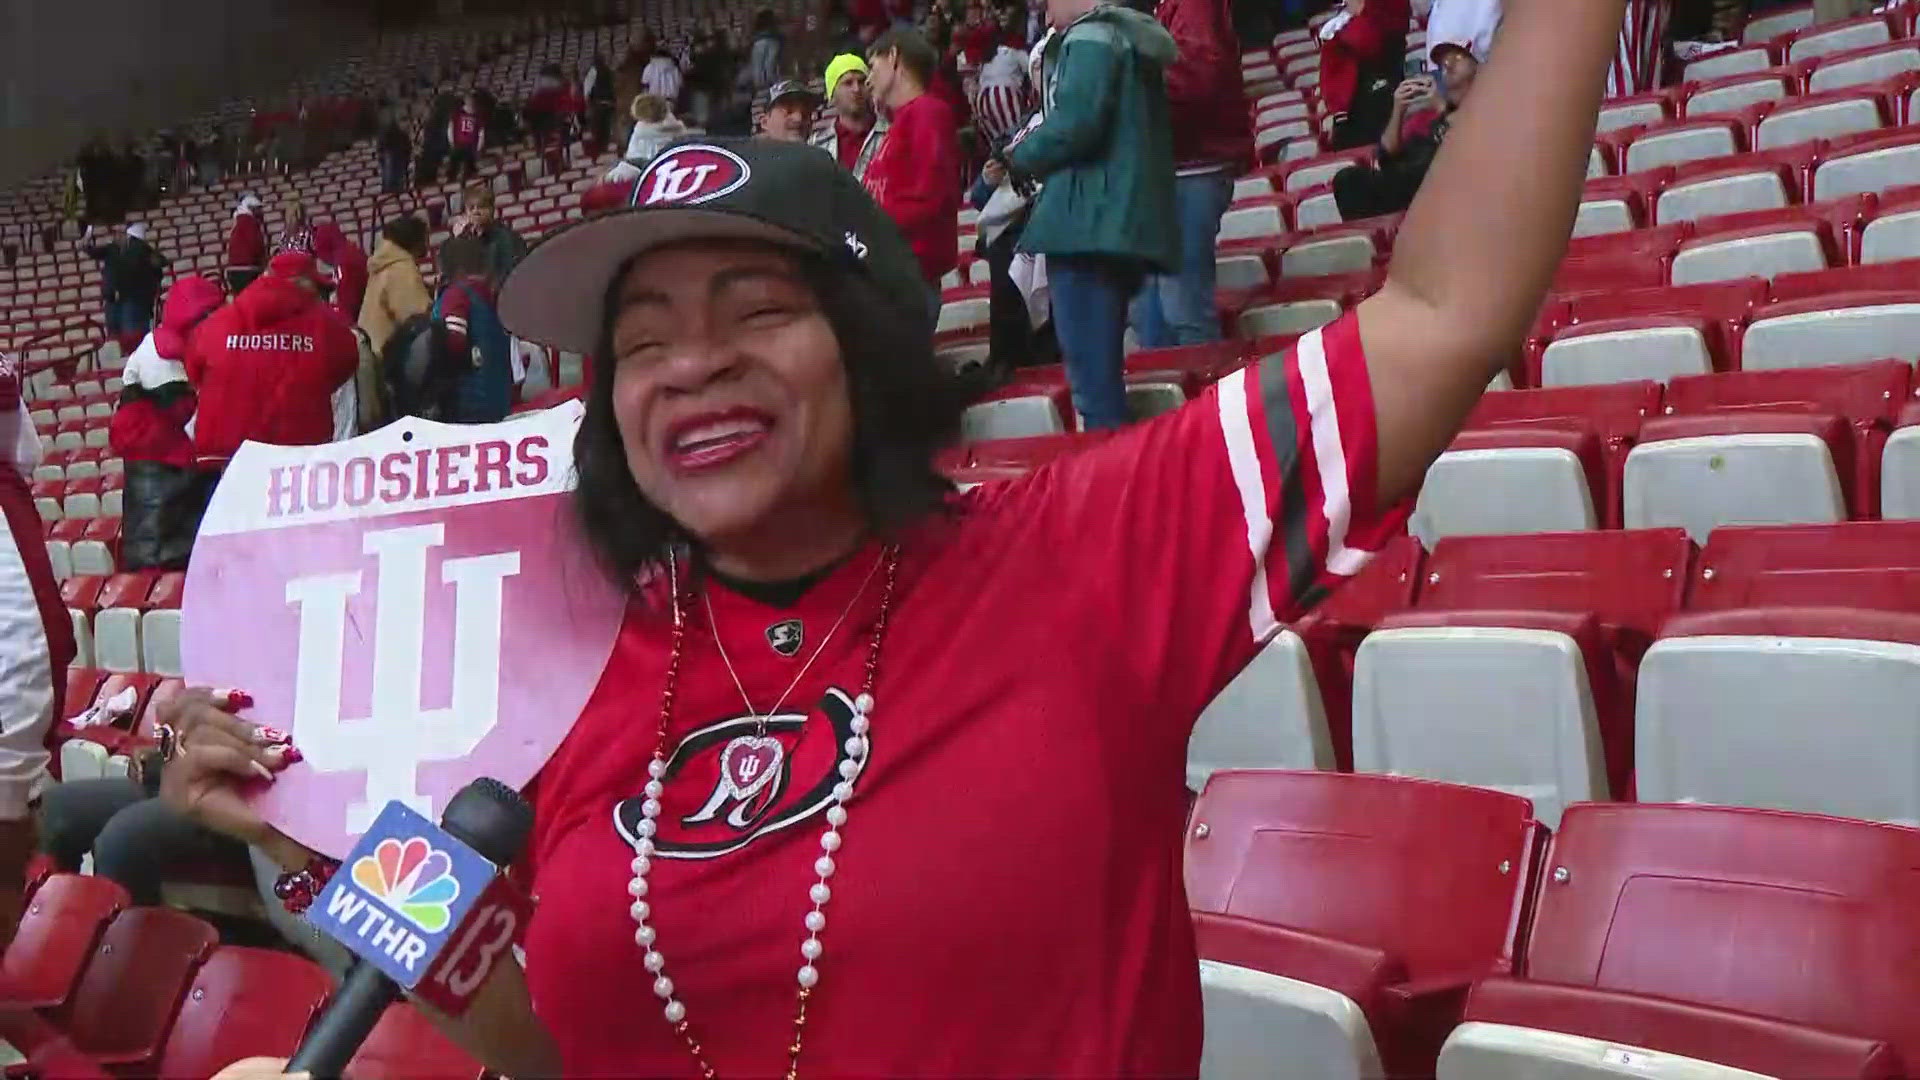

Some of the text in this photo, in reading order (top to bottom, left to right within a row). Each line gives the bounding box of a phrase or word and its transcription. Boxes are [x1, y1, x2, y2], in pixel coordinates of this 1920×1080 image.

[645, 159, 718, 206] IU
[226, 333, 314, 352] HOOSIERS
[266, 435, 549, 518] HOOSIERS
[285, 522, 521, 835] IU
[738, 754, 761, 783] IU
[326, 883, 427, 972] WTHR
[434, 904, 516, 996] 13
